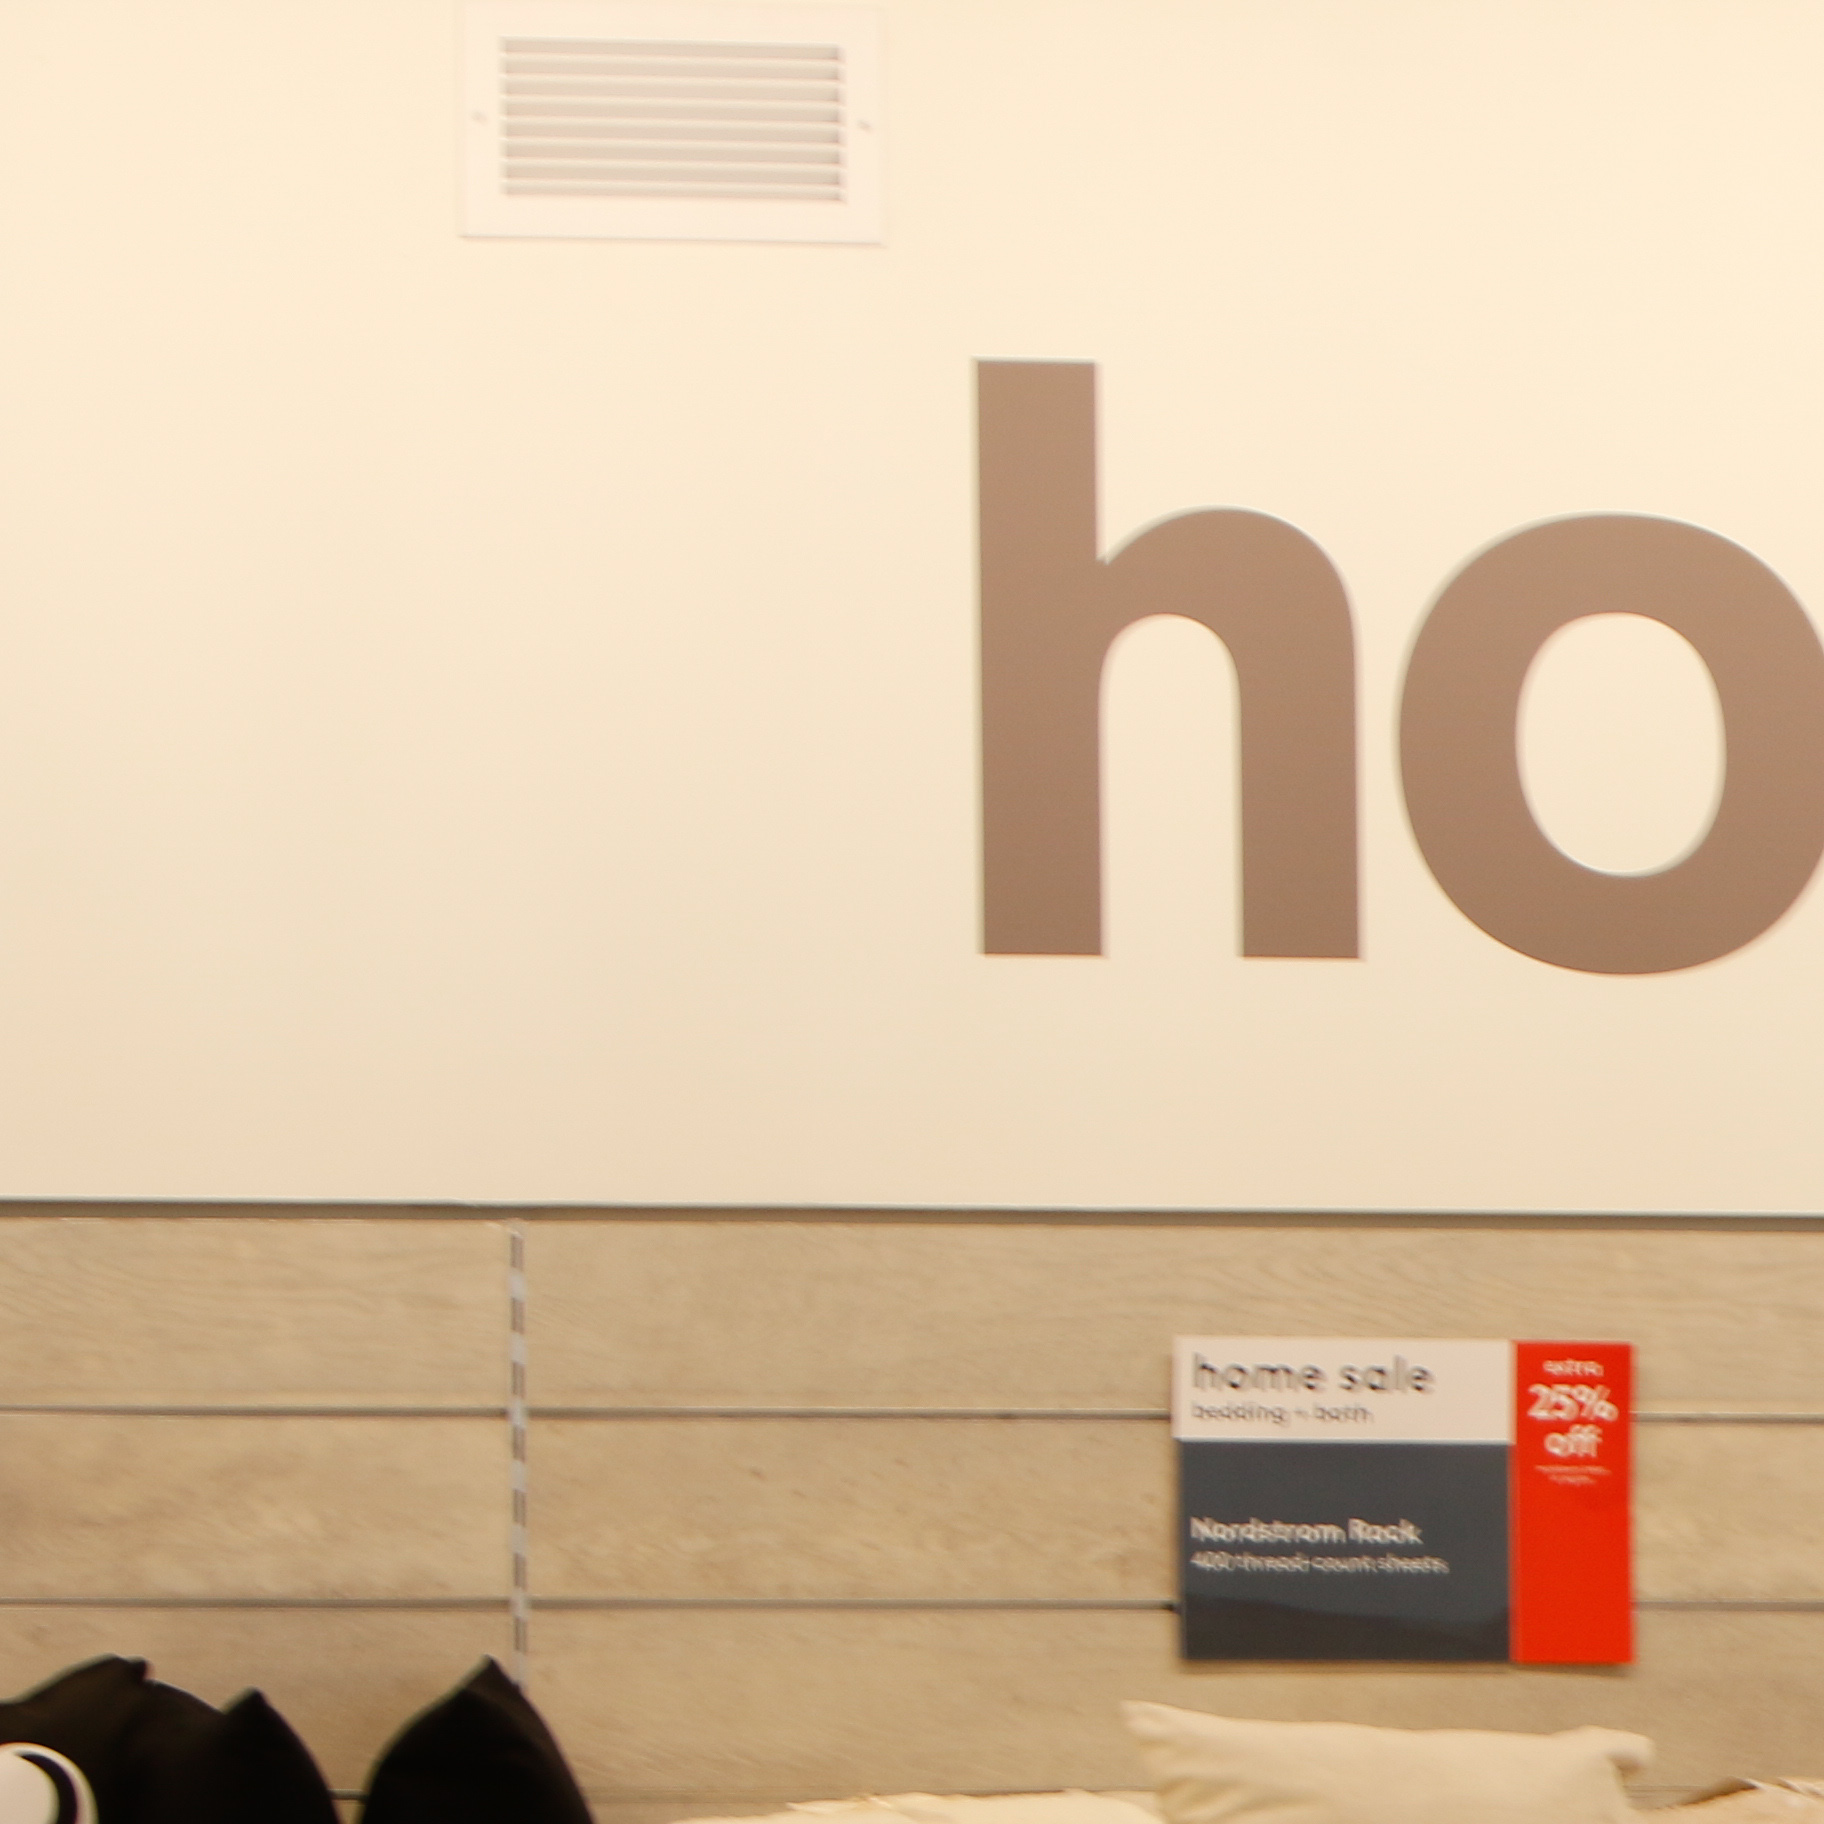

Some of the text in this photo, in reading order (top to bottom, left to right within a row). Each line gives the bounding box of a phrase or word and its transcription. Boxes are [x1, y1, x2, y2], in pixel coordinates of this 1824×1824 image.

[1191, 1352, 1435, 1394] home sale
[1191, 1400, 1288, 1426] bedding
[1313, 1402, 1375, 1424] bath
[1526, 1382, 1620, 1422] 25%
[1543, 1423, 1604, 1459] off
[1190, 1516, 1424, 1545] Nordstrom Rack
